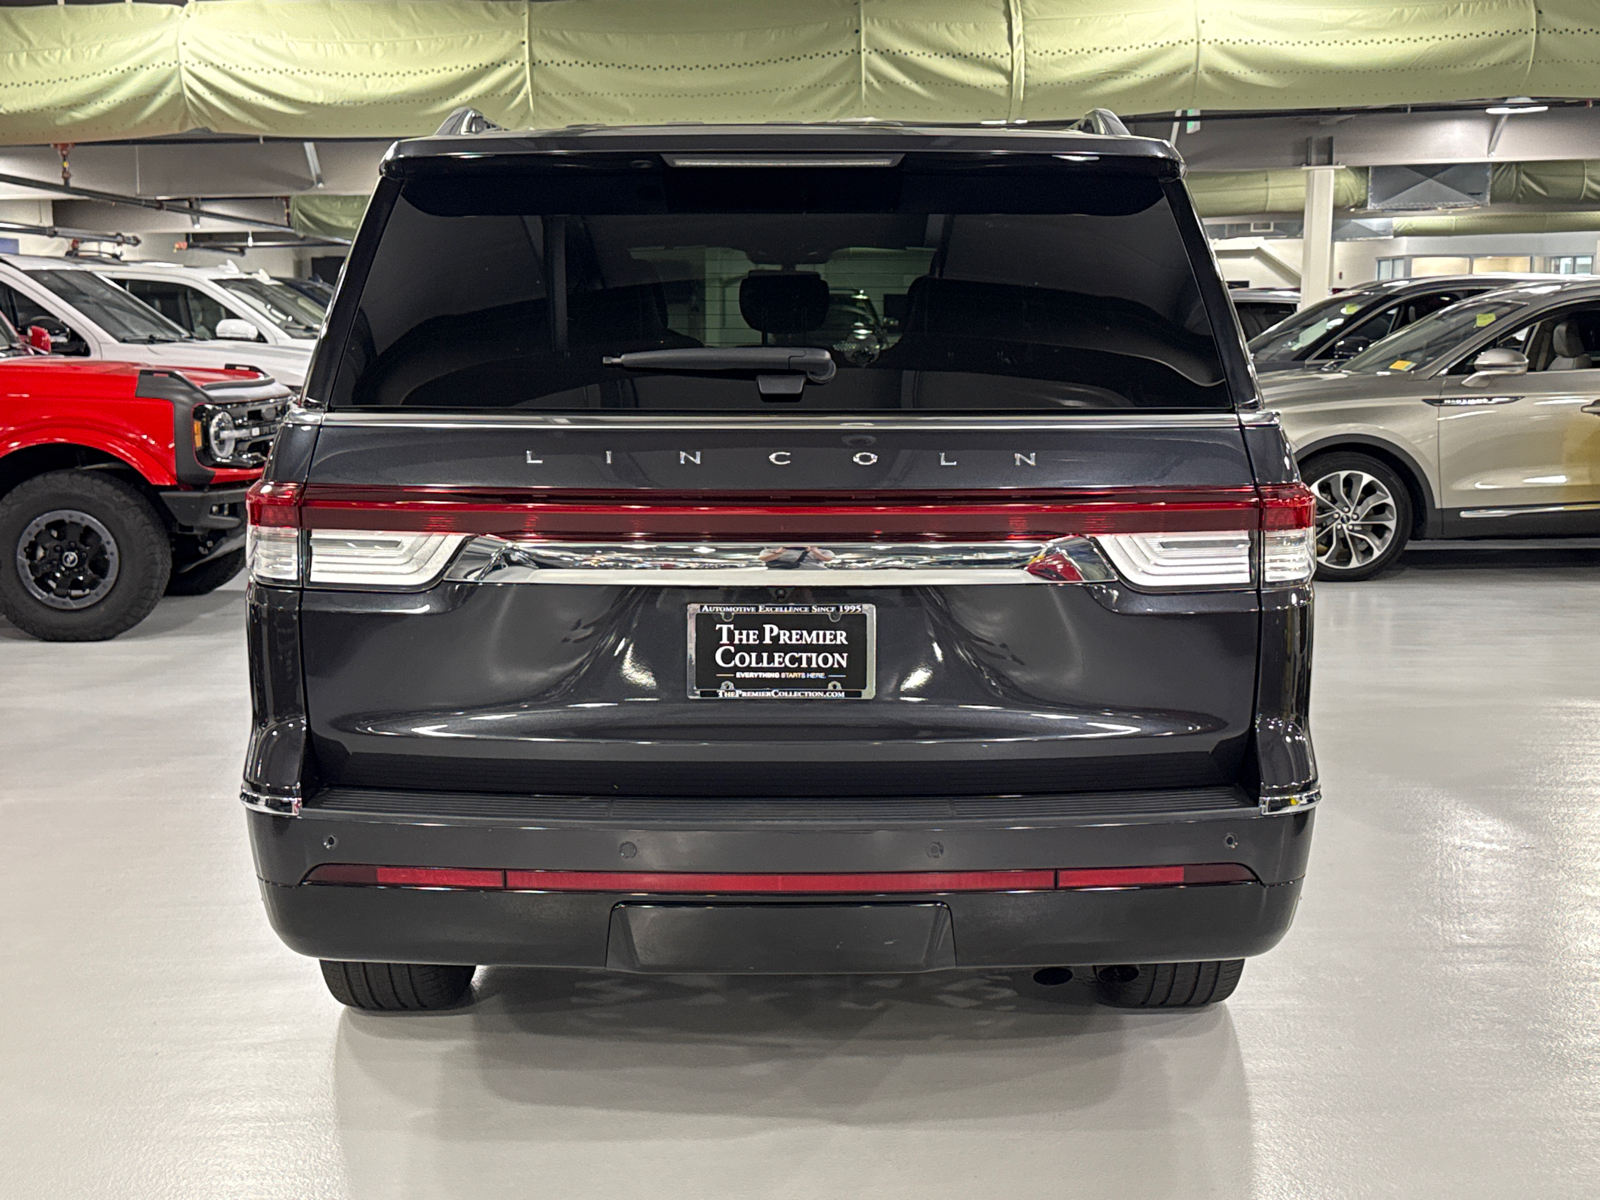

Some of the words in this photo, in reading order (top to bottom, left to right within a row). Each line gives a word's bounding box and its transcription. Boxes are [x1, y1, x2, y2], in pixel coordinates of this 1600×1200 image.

[525, 450, 1037, 466] LINCOLN
[702, 605, 756, 613] AUTOMOTIVE
[758, 605, 810, 613] EXCELLENCE
[812, 605, 837, 613] SINCE
[839, 605, 862, 613] 1995
[715, 624, 759, 645] THE
[762, 624, 849, 645] PREMIER
[715, 646, 848, 668] COLLECTION
[735, 671, 780, 679] EVERYTHING
[780, 671, 806, 679] STARTS
[716, 689, 845, 698] THEPREMIERCOLLECTION.COM
